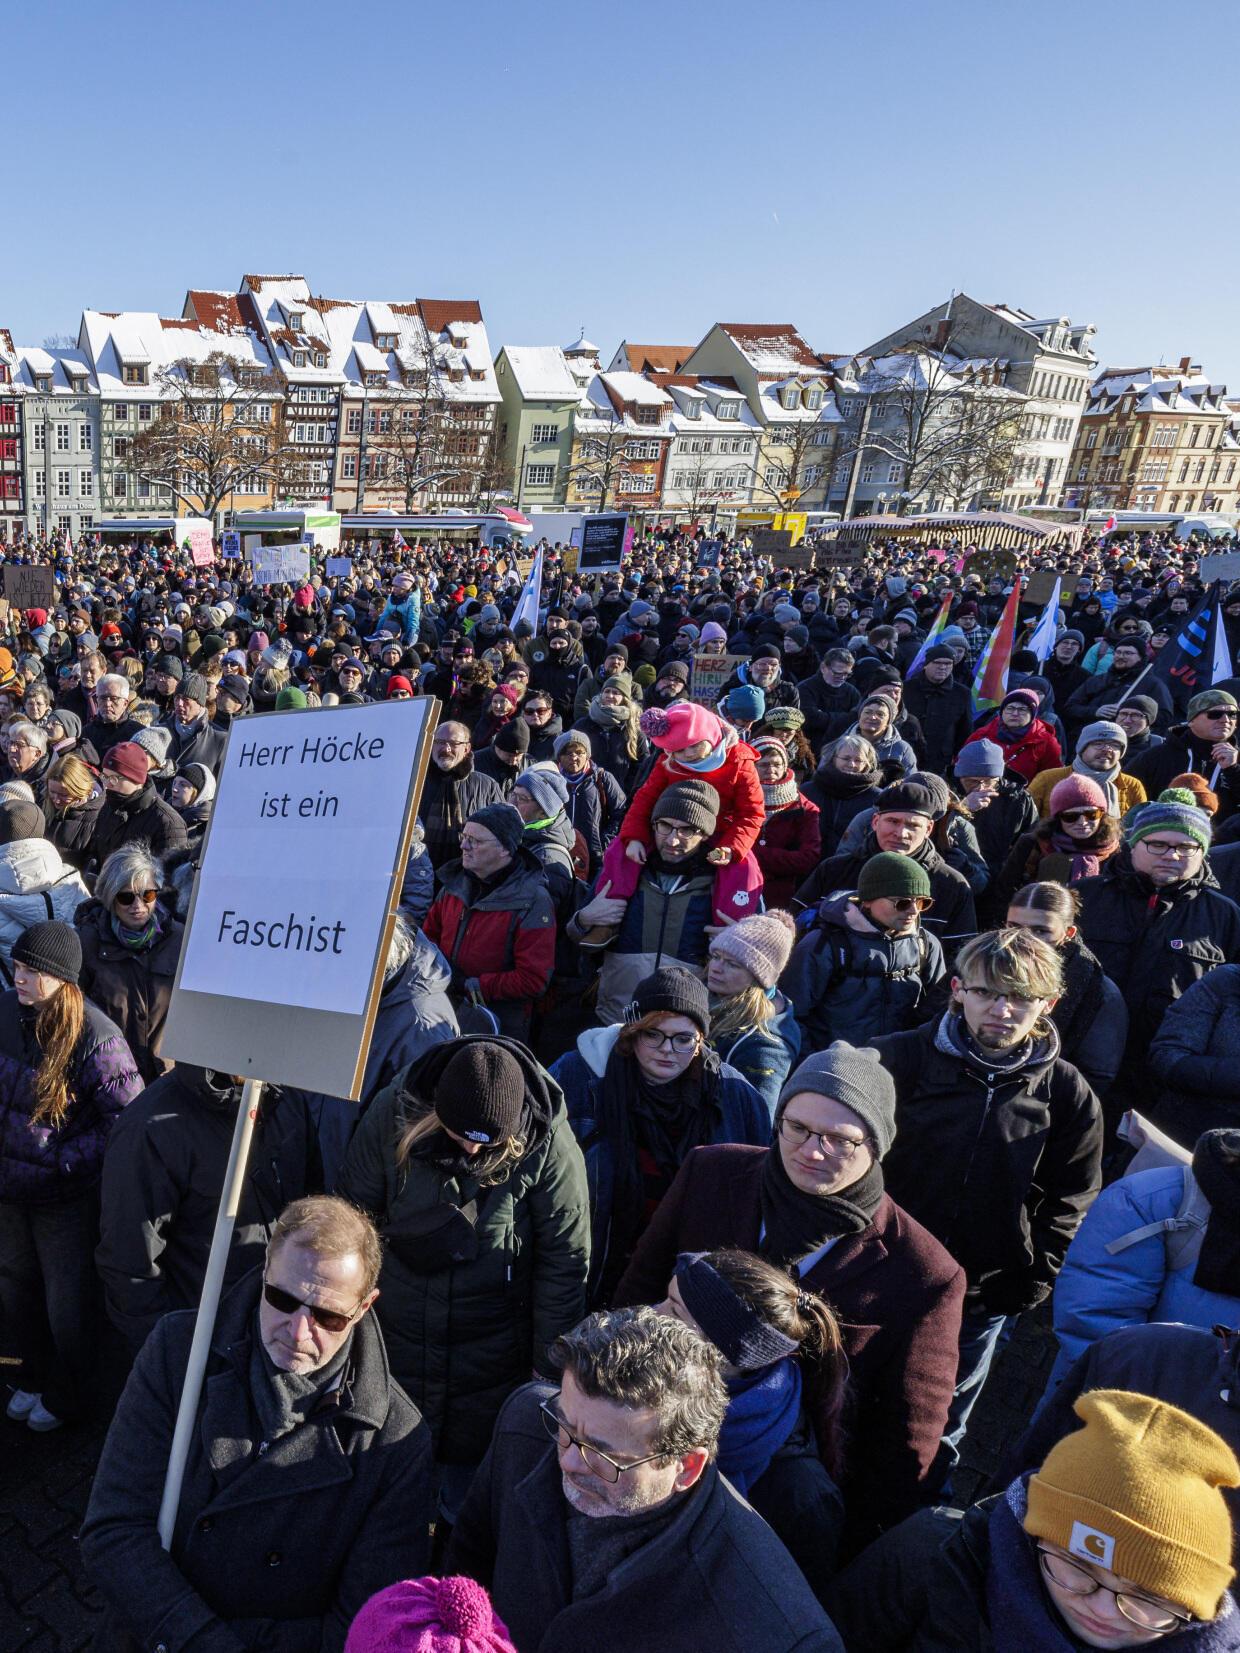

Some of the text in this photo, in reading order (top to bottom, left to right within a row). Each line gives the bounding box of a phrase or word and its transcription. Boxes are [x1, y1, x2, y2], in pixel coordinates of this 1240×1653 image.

[20, 570, 40, 581] NIE
[14, 580, 45, 592] WIEDER
[695, 658, 727, 672] HERZ
[694, 672, 722, 684] HIRN
[238, 731, 385, 769] Herr Höcke
[260, 791, 339, 818] ist ein
[217, 910, 346, 955] Faschist
